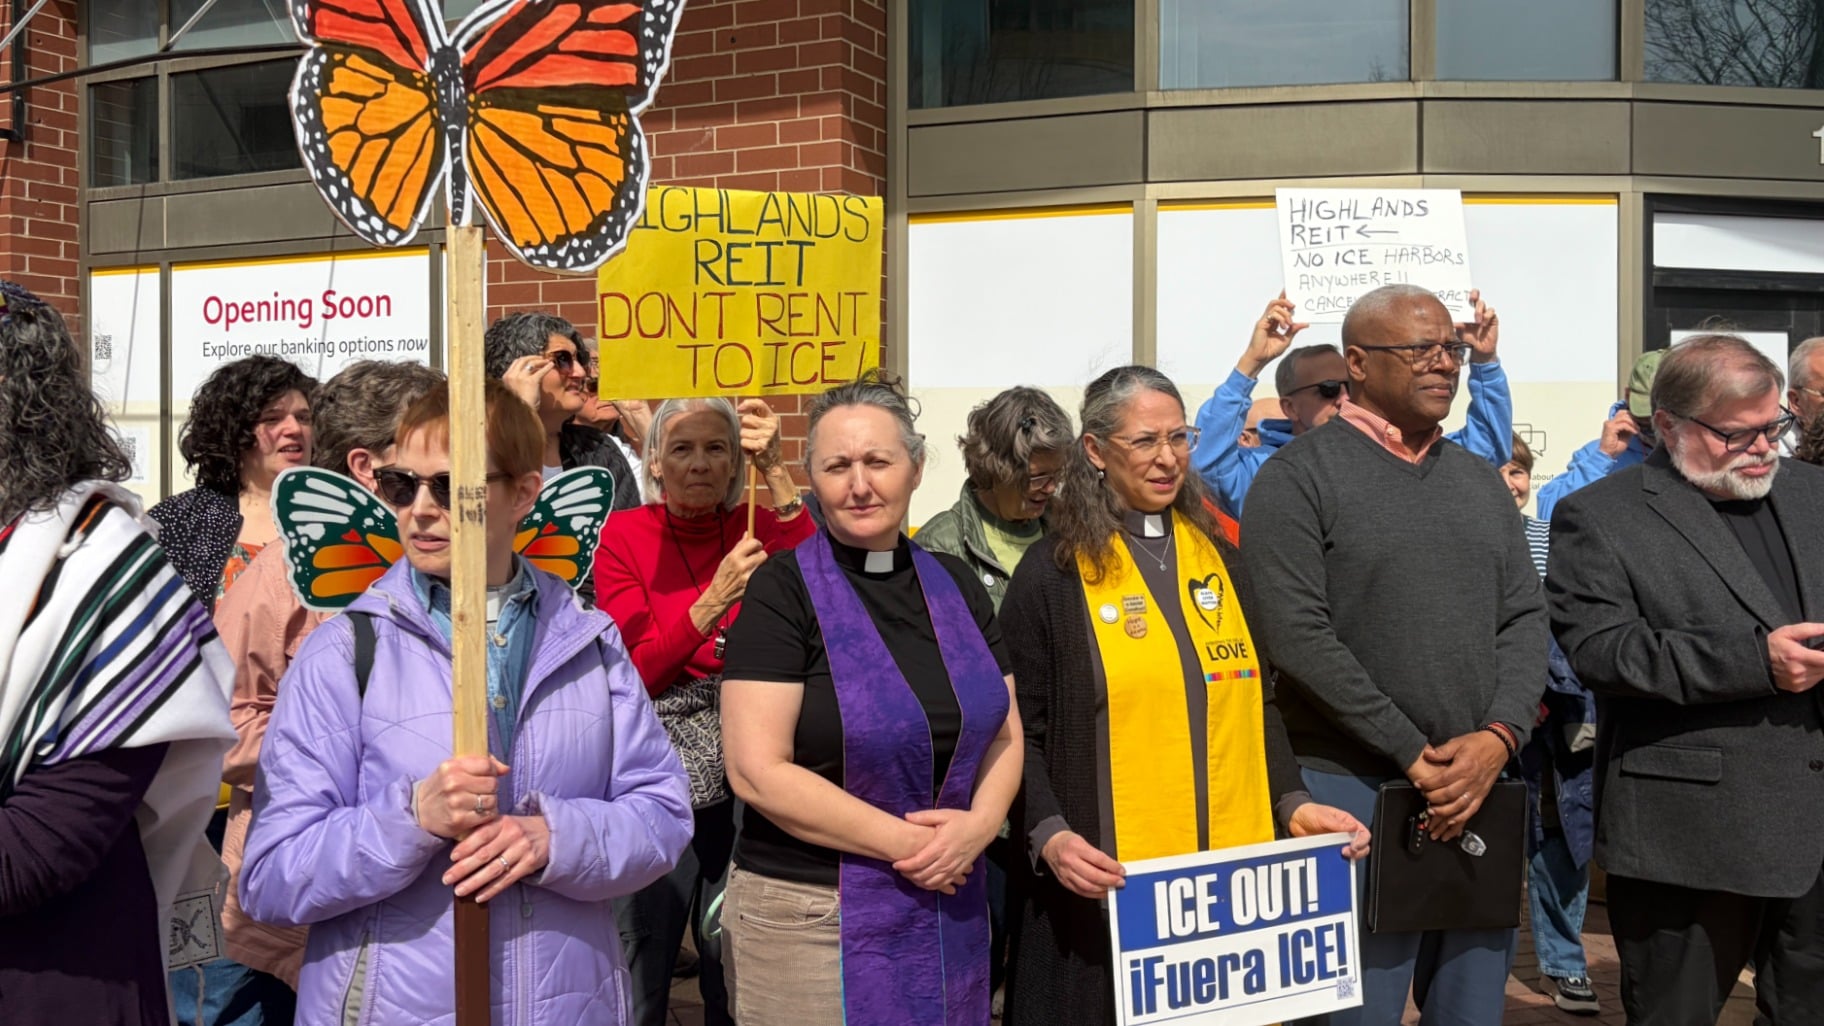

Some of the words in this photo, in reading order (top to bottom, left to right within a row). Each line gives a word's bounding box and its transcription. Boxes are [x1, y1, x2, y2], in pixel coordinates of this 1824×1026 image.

[636, 186, 870, 242] IGHLANDS
[1289, 197, 1429, 223] HIGHLANDS
[1290, 224, 1350, 248] REIT
[1293, 252, 1324, 268] NO
[1334, 249, 1374, 265] ICE
[1384, 247, 1465, 266] HARBORS
[695, 238, 816, 287] REIT
[203, 291, 313, 332] Opening
[321, 289, 392, 320] Soon
[756, 291, 869, 338] RENT
[1304, 296, 1355, 312] CANCE
[202, 340, 251, 360] Explore
[254, 343, 278, 356] our
[281, 338, 335, 357] banking
[338, 336, 394, 356] options
[397, 338, 428, 351] now
[677, 342, 754, 389] TO
[1206, 642, 1249, 662] LOVE
[1154, 873, 1221, 940] ICE
[1230, 857, 1319, 926] OUT!
[1278, 921, 1349, 989] ICE!
